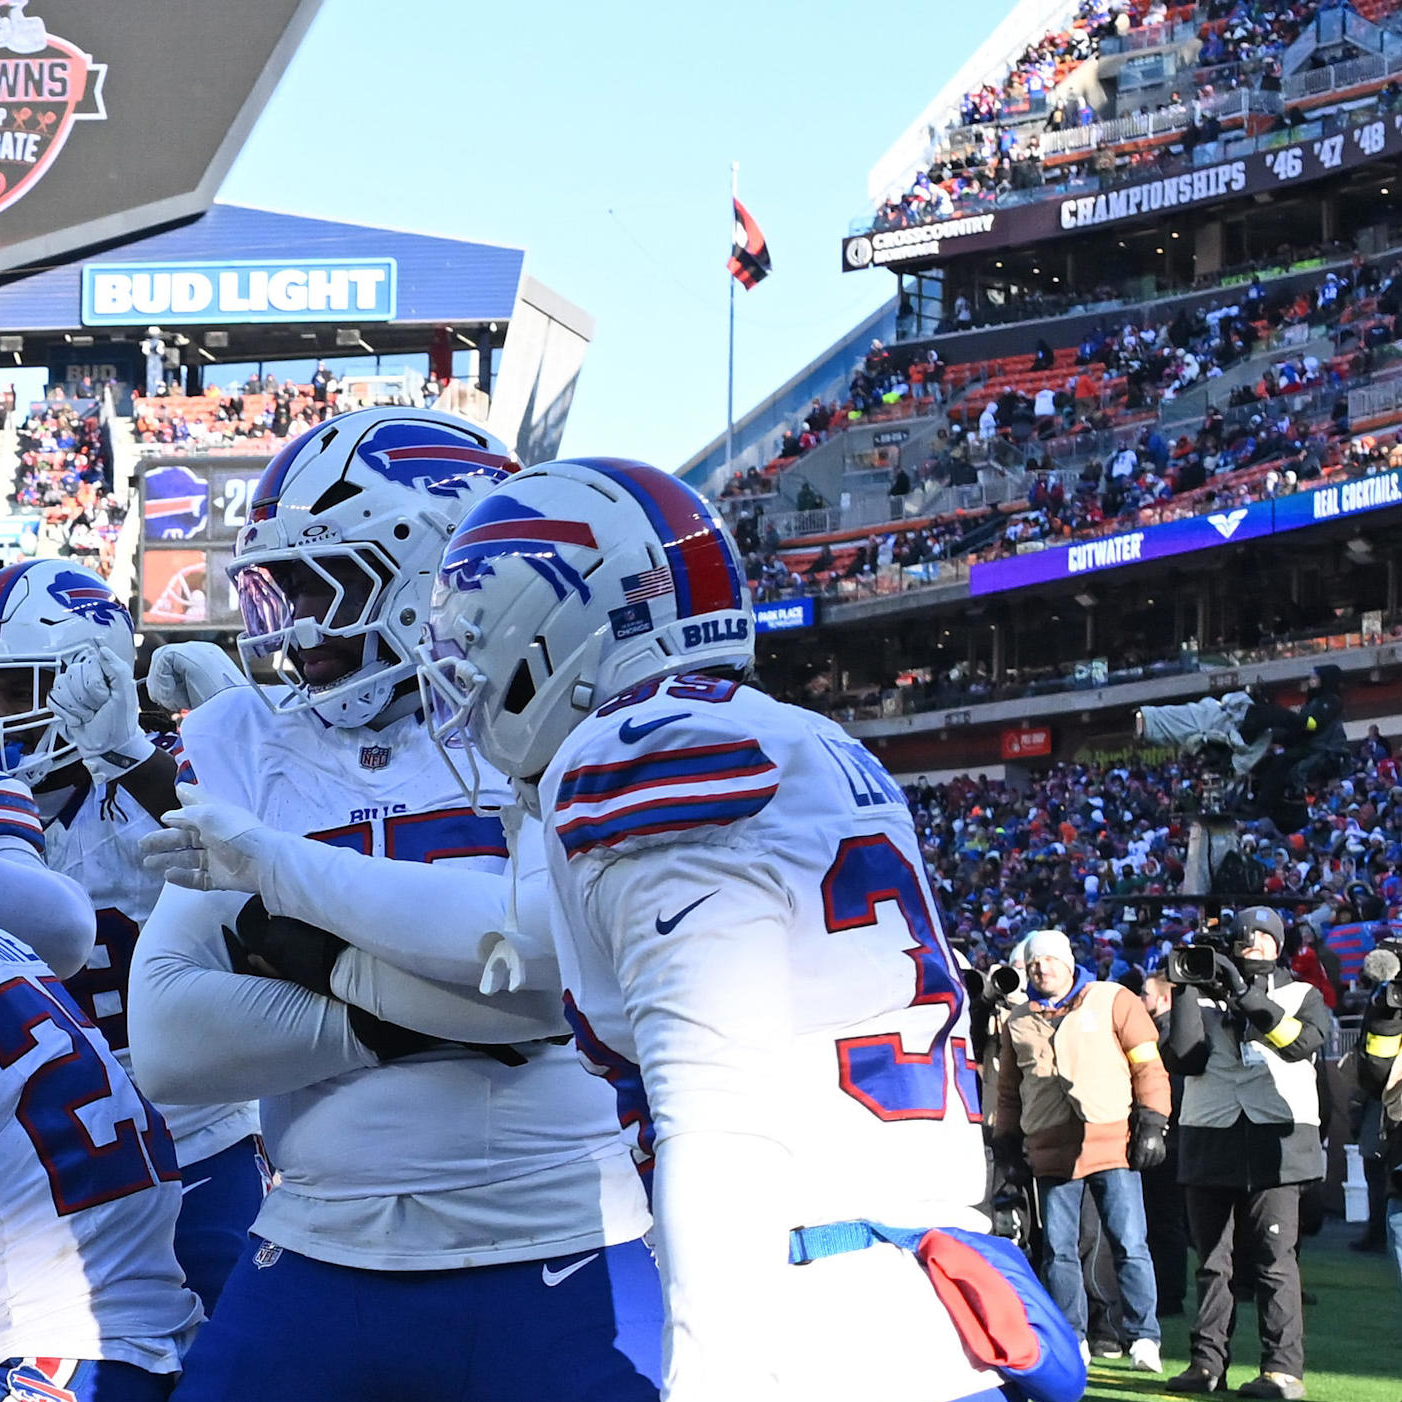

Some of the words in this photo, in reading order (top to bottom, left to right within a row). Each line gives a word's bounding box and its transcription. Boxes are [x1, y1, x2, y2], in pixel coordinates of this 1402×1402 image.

[1060, 161, 1246, 230] CHAMPIONSHIPS
[1265, 147, 1303, 181] '46
[1313, 134, 1345, 169] '47
[94, 272, 214, 315] BUD
[218, 269, 386, 312] LIGHT
[66, 364, 117, 382] BUD
[1313, 489, 1340, 519] REAL
[779, 605, 804, 620] PLACE
[682, 618, 747, 648] BILLS
[362, 754, 388, 769] NFL
